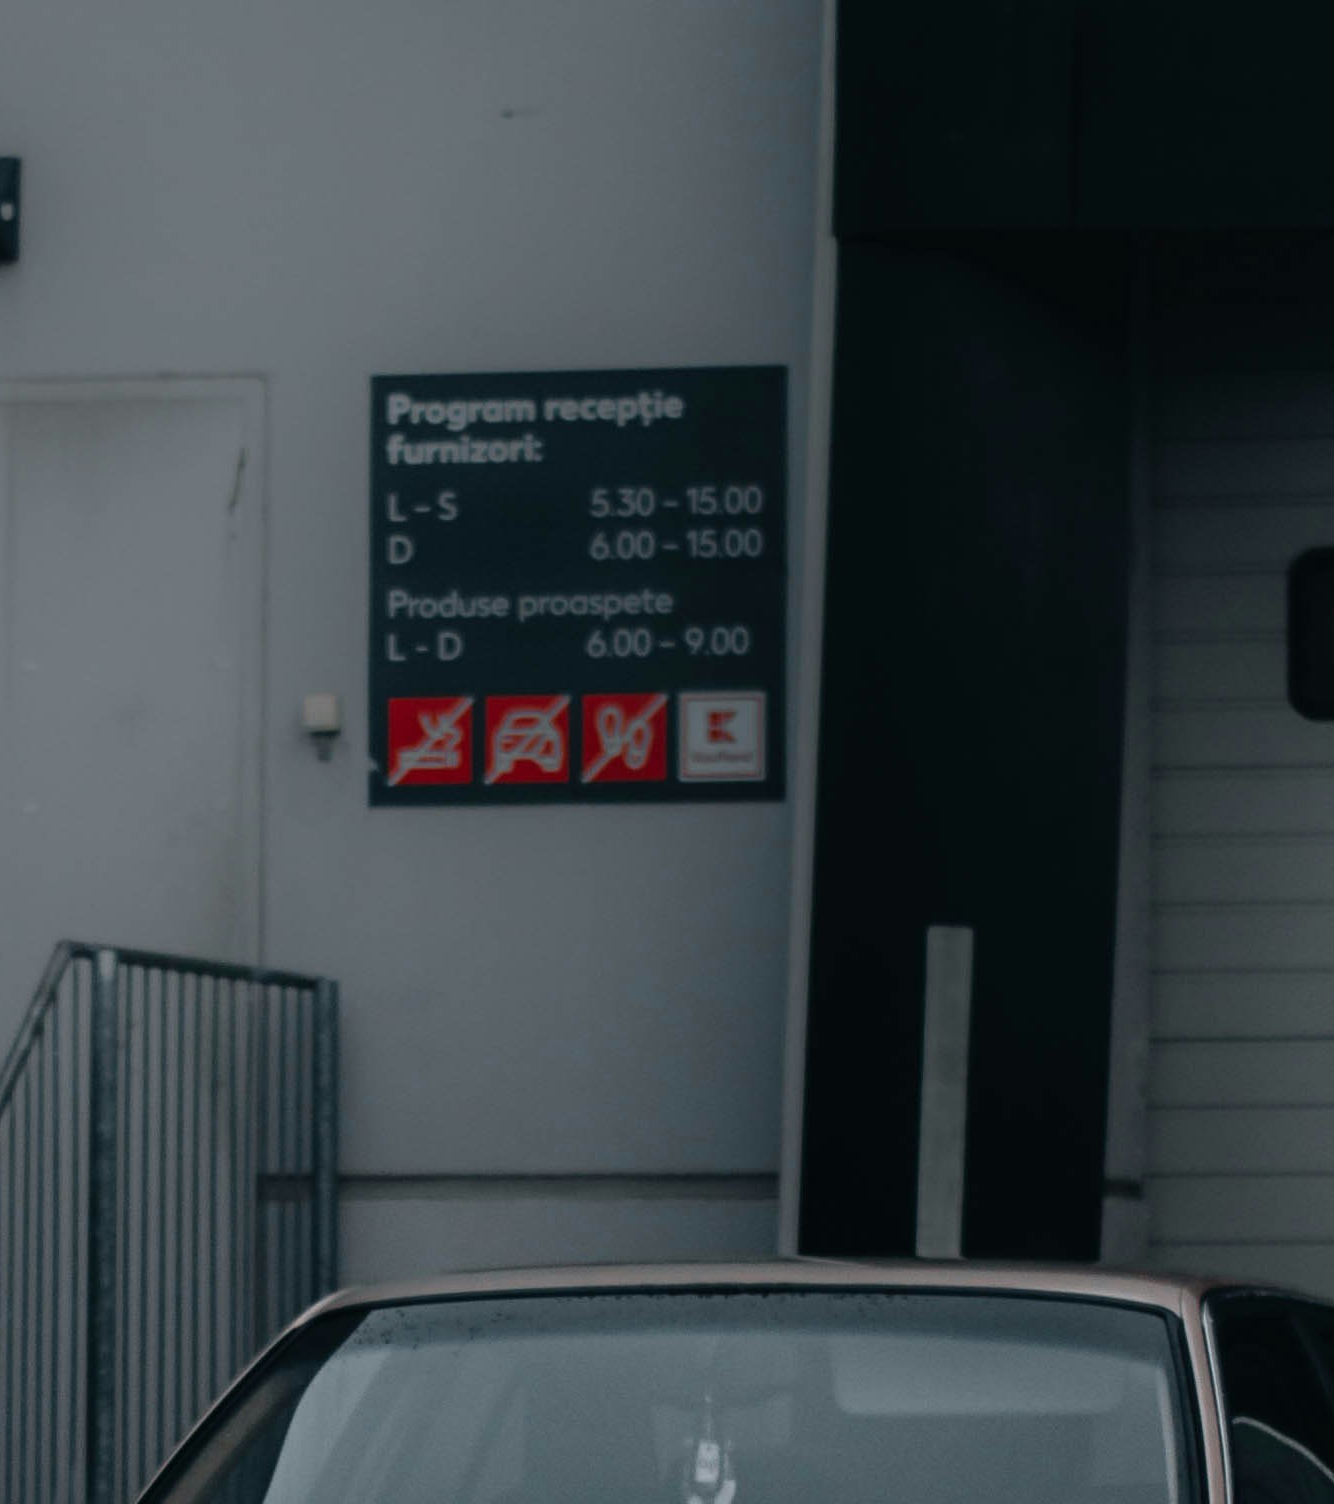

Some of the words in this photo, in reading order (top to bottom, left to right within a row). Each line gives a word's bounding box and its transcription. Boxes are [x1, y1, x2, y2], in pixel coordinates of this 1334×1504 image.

[386, 392, 535, 431] Program
[385, 433, 543, 465] furnizori:
[386, 492, 407, 522] L
[437, 491, 458, 521] S
[589, 486, 655, 518] 5.30
[685, 484, 763, 515] 15.00
[386, 533, 414, 564] D
[588, 529, 655, 560] 6.00
[685, 527, 763, 558] 15.00
[386, 587, 509, 619] Produse
[517, 588, 673, 622] proaspete
[386, 632, 406, 661] L
[438, 629, 463, 661] D
[585, 626, 653, 658] 6.00
[684, 625, 750, 656] 9.00
